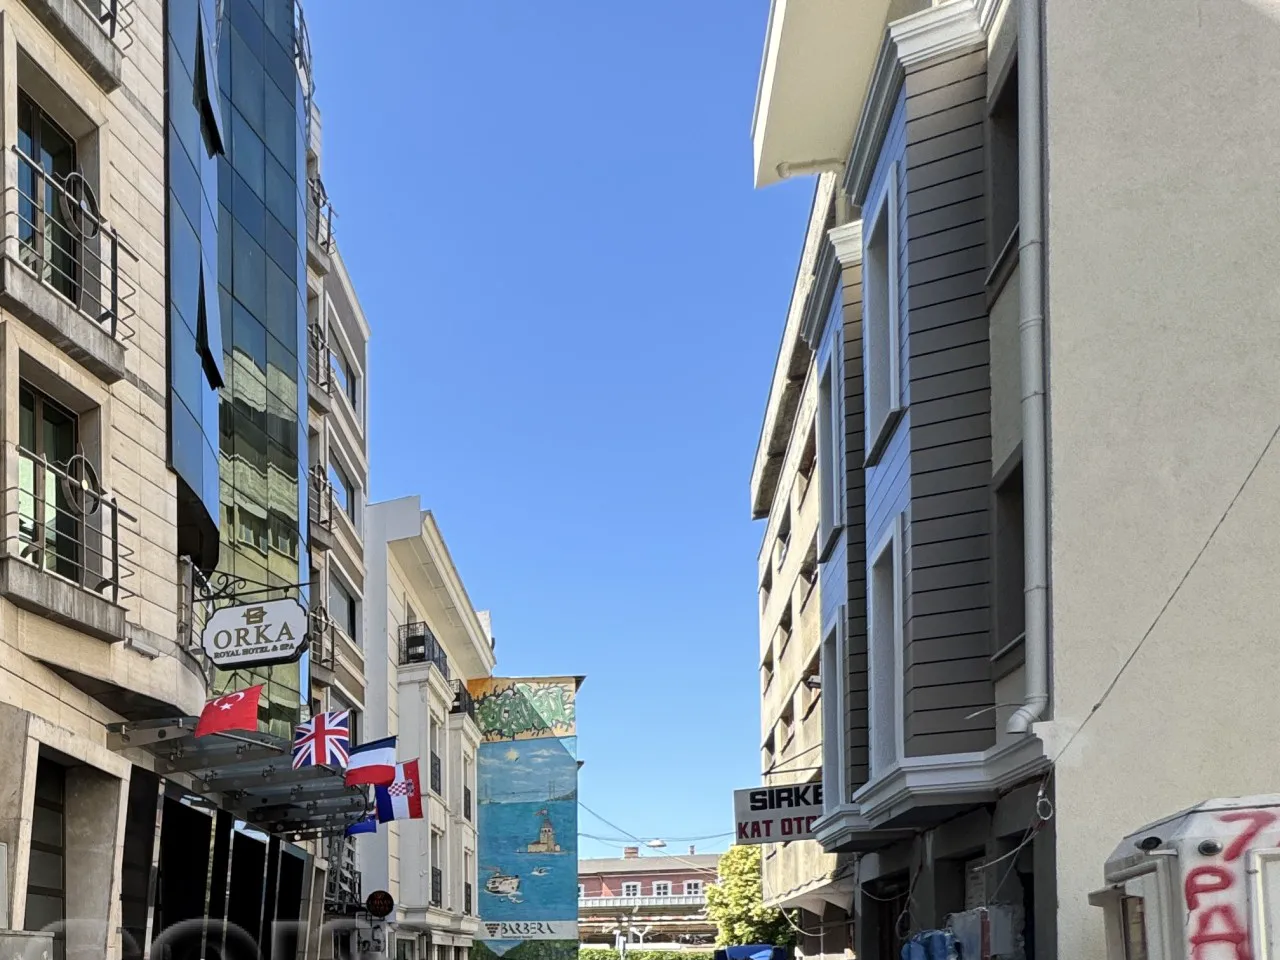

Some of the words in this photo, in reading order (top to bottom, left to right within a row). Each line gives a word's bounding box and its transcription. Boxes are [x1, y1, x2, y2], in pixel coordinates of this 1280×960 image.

[213, 621, 295, 650] ORKA
[242, 645, 270, 656] HOTEL
[280, 642, 294, 650] SPA
[738, 820, 773, 839] KAT
[781, 815, 822, 835] OTO
[501, 922, 556, 935] BARBERA
